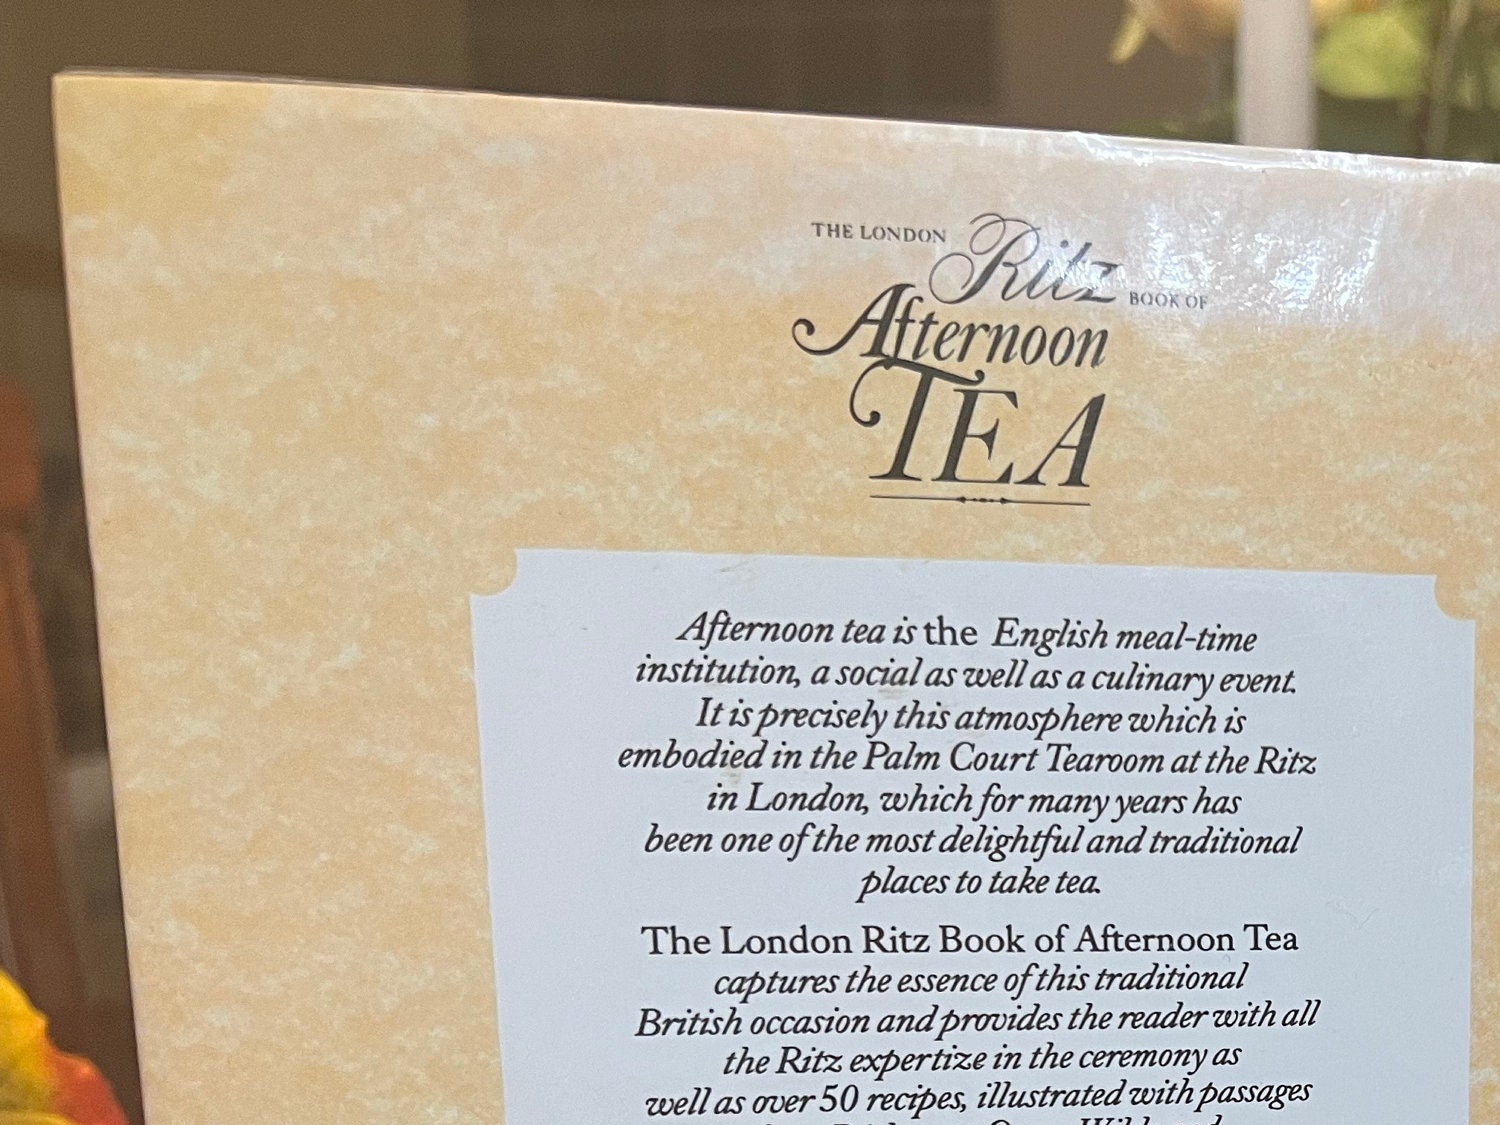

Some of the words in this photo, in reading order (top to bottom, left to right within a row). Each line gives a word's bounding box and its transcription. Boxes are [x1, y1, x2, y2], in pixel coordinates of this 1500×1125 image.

[811, 222, 853, 240] THE
[858, 224, 947, 243] LONDON
[928, 213, 1123, 304] Ritz
[1129, 291, 1179, 309] BOOK
[1185, 294, 1209, 310] OF
[791, 283, 1109, 368] Afternoon
[849, 358, 1107, 488] TEA
[675, 610, 834, 651] Afternoon
[841, 619, 886, 644] tea
[893, 616, 918, 645] is
[923, 615, 977, 646] the
[991, 617, 1108, 657] English
[1116, 621, 1257, 652] meal-time
[636, 654, 800, 688] institution,
[811, 666, 830, 685] a
[835, 657, 923, 686] social
[924, 668, 958, 687] as
[963, 658, 1029, 688] well
[1030, 670, 1062, 689] as
[1067, 671, 1085, 689] a
[1092, 661, 1214, 702] culinary
[1220, 671, 1295, 694] event.
[696, 697, 724, 726] It
[729, 698, 753, 727] is
[752, 699, 888, 739] precisely
[893, 699, 951, 729] this
[955, 702, 1123, 741] atmosphere
[1128, 704, 1216, 733] which
[1224, 707, 1246, 734] is
[618, 738, 769, 769] embodied
[771, 741, 802, 769] in
[810, 740, 858, 769] the
[862, 741, 940, 770] Palm
[950, 741, 1039, 771] Court
[1046, 743, 1164, 773] Tearoom
[1171, 750, 1202, 773] at
[1205, 745, 1249, 774] the
[1254, 746, 1317, 774] Ritz
[707, 783, 738, 811] in
[745, 782, 869, 815] London,
[880, 783, 973, 812] which
[972, 783, 1024, 822] for
[1028, 794, 1110, 823] many
[1111, 795, 1188, 823] years
[1192, 785, 1242, 814] has
[645, 823, 713, 852] been
[721, 833, 773, 852] one
[779, 822, 816, 862] of
[812, 823, 860, 852] the
[865, 830, 936, 852] most
[938, 824, 1085, 862] delightful
[1086, 825, 1147, 853] and
[1149, 826, 1303, 854] traditional
[855, 865, 950, 903] places
[955, 871, 982, 894] to
[988, 866, 1050, 894] take
[1055, 871, 1100, 894] tea.
[641, 925, 711, 955] The
[720, 924, 853, 954] London
[861, 925, 930, 953] Ritz
[939, 924, 1026, 953] Book
[1035, 924, 1069, 952] of
[1073, 924, 1235, 952] Afternoon
[1243, 924, 1299, 950] Tea
[714, 971, 840, 1004] captures
[845, 965, 892, 993] the
[897, 974, 998, 992] essence
[1004, 963, 1039, 1001] of
[1035, 963, 1090, 991] this
[1095, 962, 1249, 990] traditional
[634, 1006, 742, 1036] British
[750, 1007, 870, 1034] occasion
[877, 1004, 939, 1033] and
[934, 1003, 1063, 1041] provides
[1067, 1003, 1113, 1030] the
[1118, 1001, 1209, 1029] reader
[1213, 1000, 1276, 1028] with
[1282, 999, 1321, 1026] all
[723, 1046, 770, 1074] the
[775, 1046, 843, 1074] Ritz
[850, 1044, 987, 1081] expertize
[993, 1044, 1022, 1069] in
[1029, 1042, 1074, 1069] the
[1079, 1049, 1208, 1075] ceremony
[1212, 1048, 1242, 1065] as
[646, 1087, 712, 1116] well
[714, 1096, 746, 1114] as
[752, 1095, 816, 1114] over
[819, 1084, 859, 1112] 50
[866, 1084, 966, 1119] recipes,
[977, 1079, 1127, 1108] illustrated
[1129, 1078, 1194, 1105] with
[1193, 1082, 1313, 1113] passages
